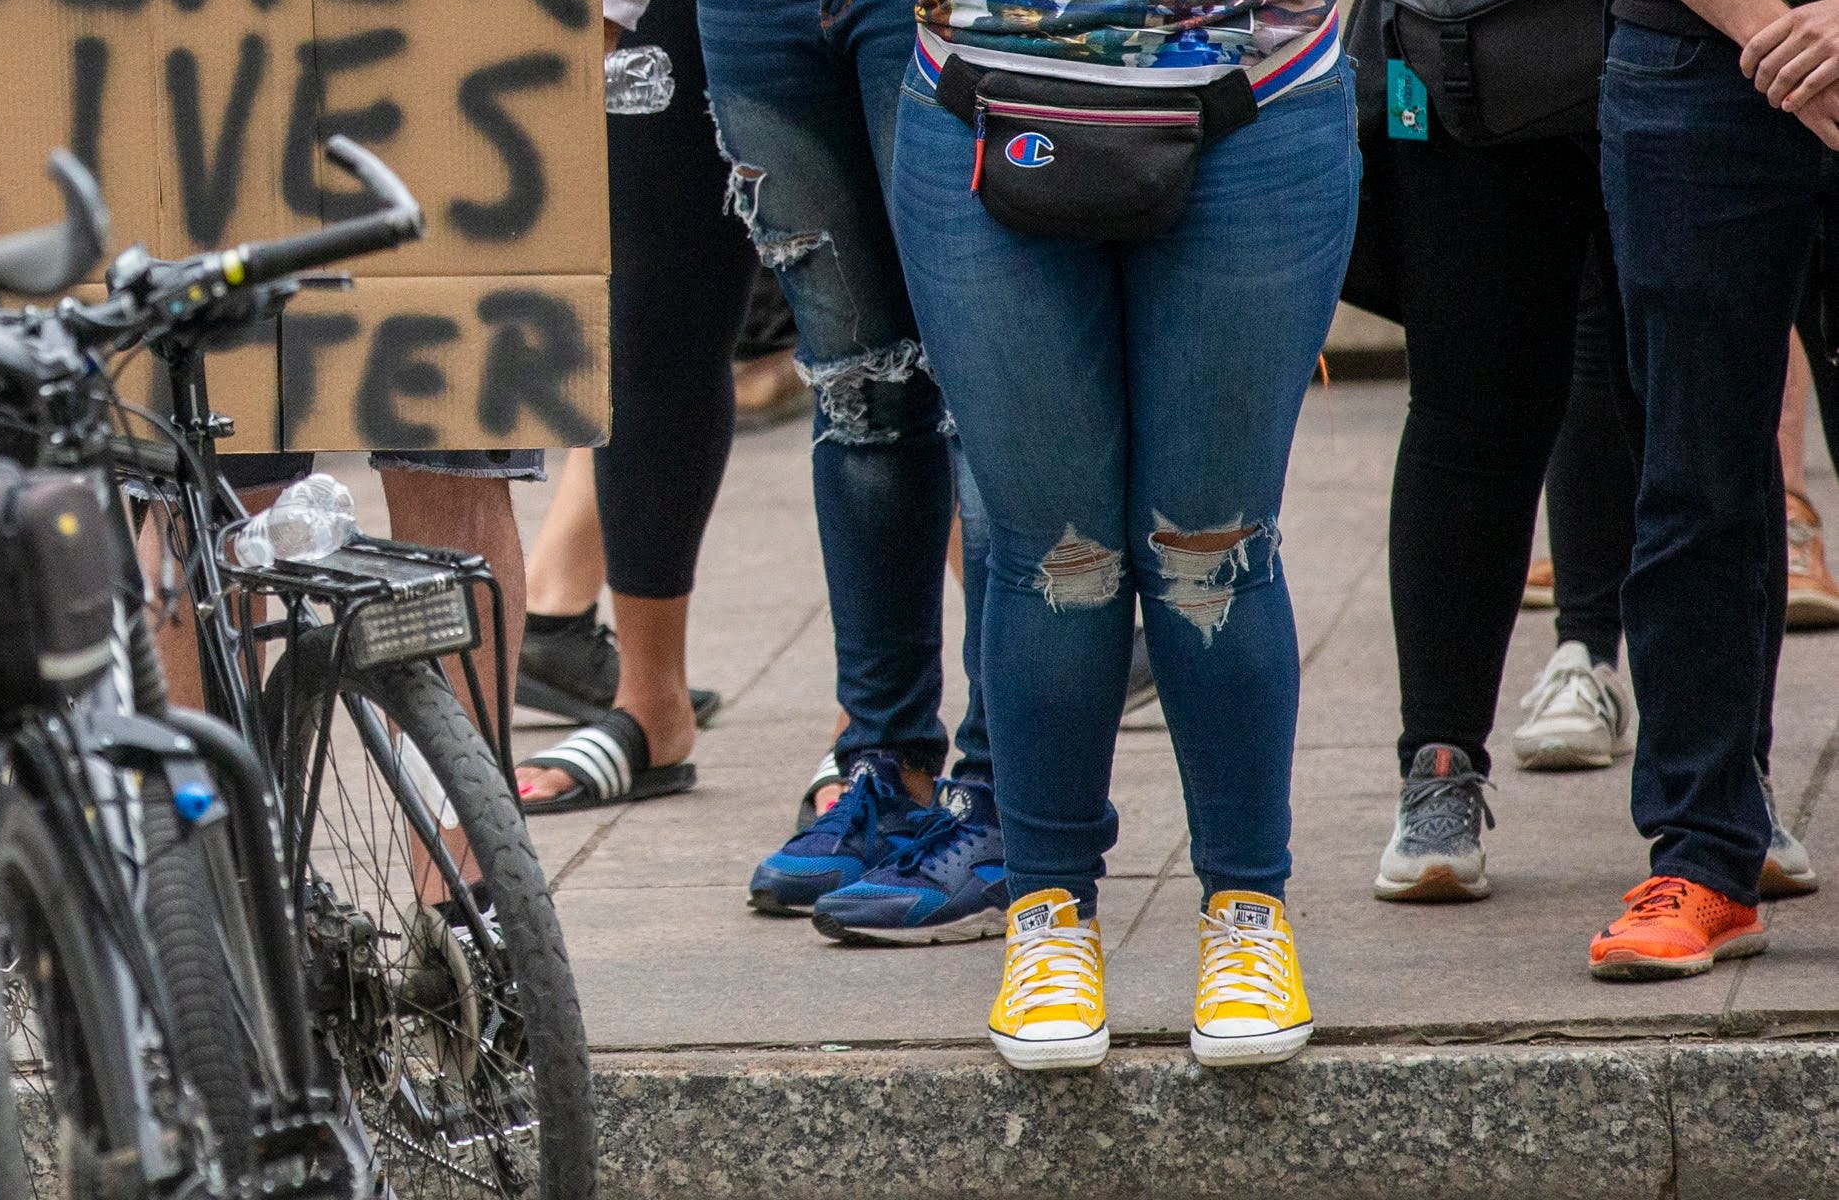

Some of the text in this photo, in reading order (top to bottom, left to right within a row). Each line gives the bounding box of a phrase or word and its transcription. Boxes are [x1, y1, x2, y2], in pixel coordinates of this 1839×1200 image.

[147, 287, 610, 448] TER
[1018, 906, 1046, 919] CONVERSE
[1238, 903, 1269, 913] CONVERSE
